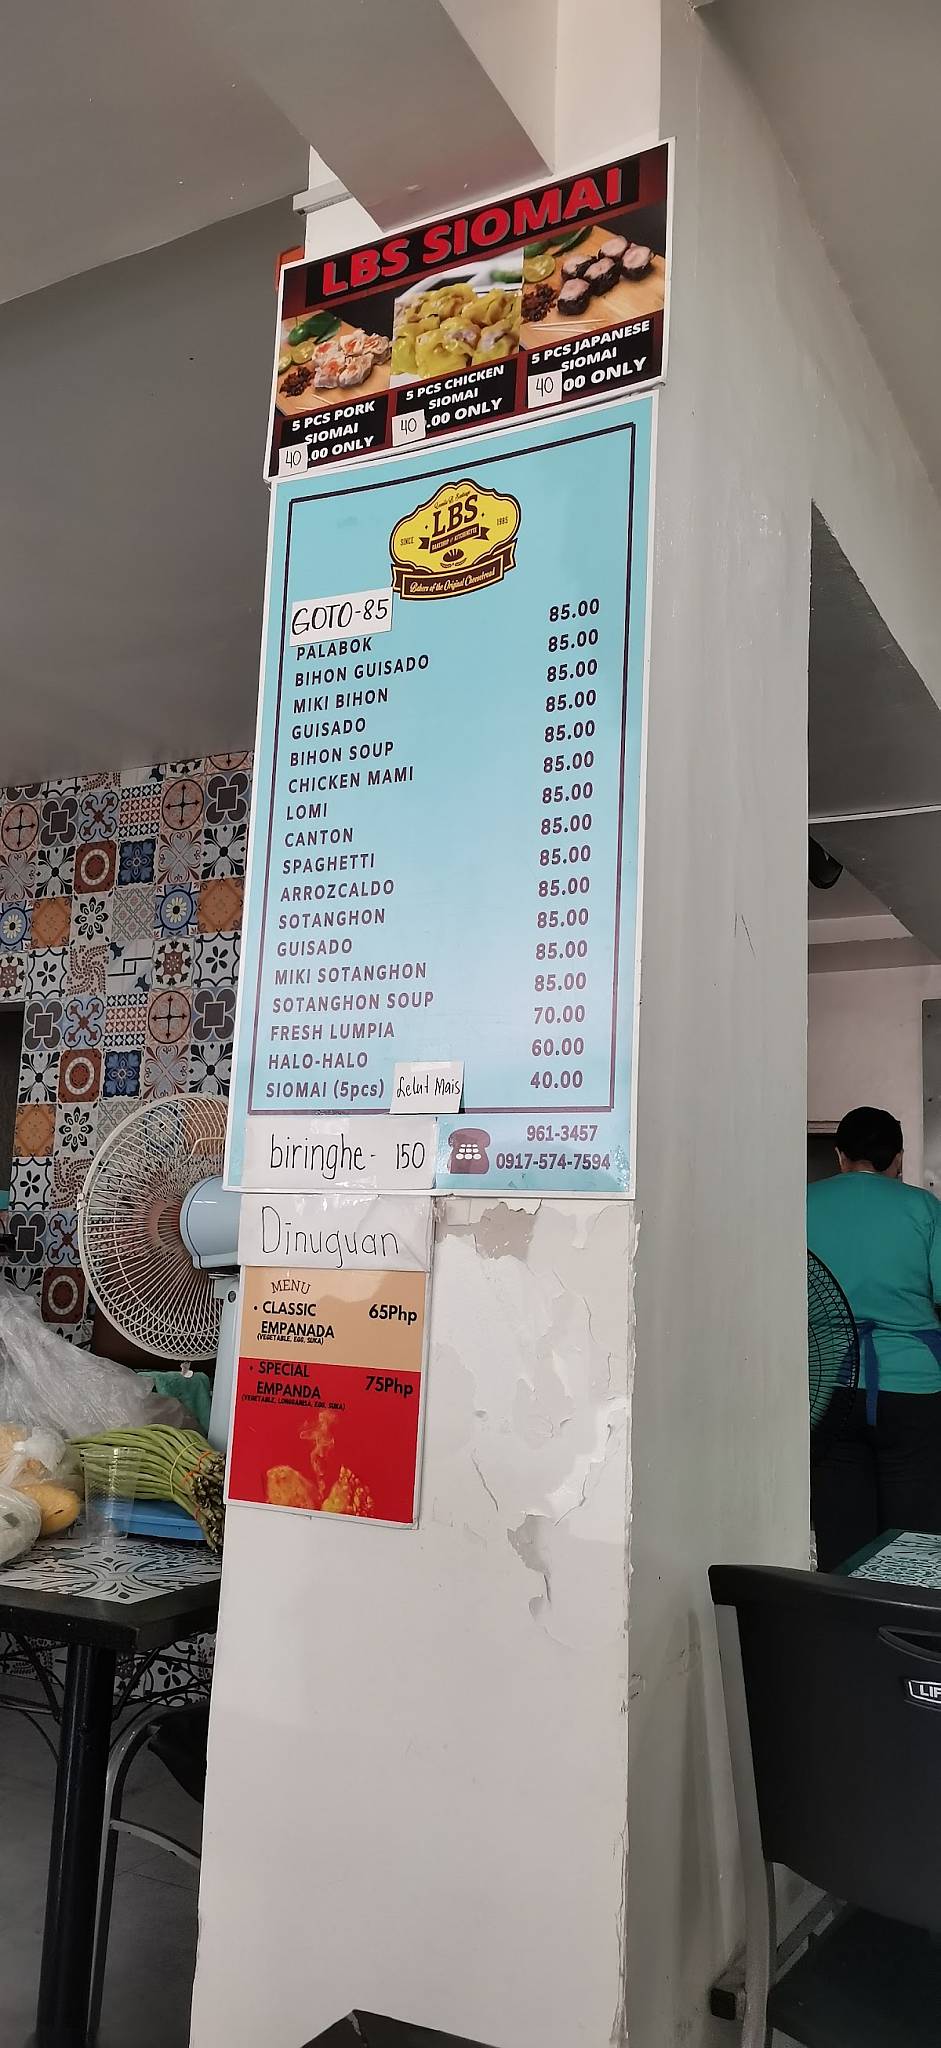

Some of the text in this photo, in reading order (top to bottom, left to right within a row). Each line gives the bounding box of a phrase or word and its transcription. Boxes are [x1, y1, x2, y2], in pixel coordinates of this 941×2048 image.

[321, 167, 623, 297] LBS SIOMAI
[531, 320, 650, 365] 5 PCS JAPANESE
[560, 347, 617, 373] SIOMAI
[590, 356, 647, 385] ONLY
[406, 364, 504, 401] 5 PCS CHICKEN
[535, 376, 554, 397] 40
[428, 388, 479, 410] SIOMAI
[454, 398, 503, 421] ONLY
[292, 400, 375, 432] 5 PCS PORK
[400, 417, 417, 433] 40
[304, 422, 359, 444] SIOMAI
[331, 435, 374, 456] ONLY
[285, 450, 302, 468] 40
[432, 495, 478, 537] LBS
[409, 581, 429, 593] Bakers
[429, 583, 436, 593] of
[436, 581, 444, 591] the
[444, 577, 465, 591] Original
[292, 598, 389, 635] GOTO-85
[549, 598, 600, 622] 85.00
[296, 637, 372, 661] PALABOK
[548, 629, 599, 652] 85.00
[295, 655, 429, 687] BIHON GUISADO
[546, 659, 598, 683] 85.00
[293, 688, 388, 714] MIKI BIHON
[545, 689, 597, 713] 85.00
[292, 717, 366, 740] GUISADO
[544, 720, 595, 743] 85.00
[290, 741, 394, 767] BIHON SOUP
[543, 751, 595, 774] 85.00
[288, 766, 414, 794] CHICKEN MAMI
[542, 782, 593, 804] 85.00
[286, 802, 328, 821] LOMI
[540, 813, 592, 836] 85.00
[284, 827, 354, 848] CANTON
[282, 853, 375, 875] SPAGHETTI
[539, 844, 591, 867] 85.00
[280, 879, 394, 902] ARROZCALDO
[538, 876, 590, 898] 85.00
[278, 908, 385, 930] SOTANGHON
[537, 908, 589, 929] 85.00
[277, 938, 353, 957] GUISADO
[535, 940, 588, 961] 85.00
[275, 962, 426, 985] MIKI SOTANGHON
[534, 972, 587, 993] 85.00
[272, 991, 434, 1013] SOTANGHON SOUP
[533, 1005, 586, 1025] 70.00
[270, 1021, 395, 1041] FRESH LUMPIA
[531, 1037, 585, 1057] 60.00
[268, 1051, 368, 1070] HALO-HALO
[266, 1078, 385, 1101] SIOMAI (5pcs)
[434, 1077, 461, 1096] Mais
[530, 1070, 584, 1089] 40.00
[526, 1125, 598, 1142] 961-3457
[395, 1142, 426, 1170] 150
[496, 1153, 610, 1170] 0917-574-7594
[261, 1205, 399, 1268] Dinuguan
[271, 1279, 311, 1295] MENU
[262, 1300, 317, 1317] CLASSIC
[368, 1303, 418, 1326] 65Php
[260, 1320, 335, 1339] EMPANADA
[258, 1361, 310, 1378] SPECIAL
[256, 1381, 321, 1399] EMPANDA
[365, 1375, 413, 1398] 75Php
